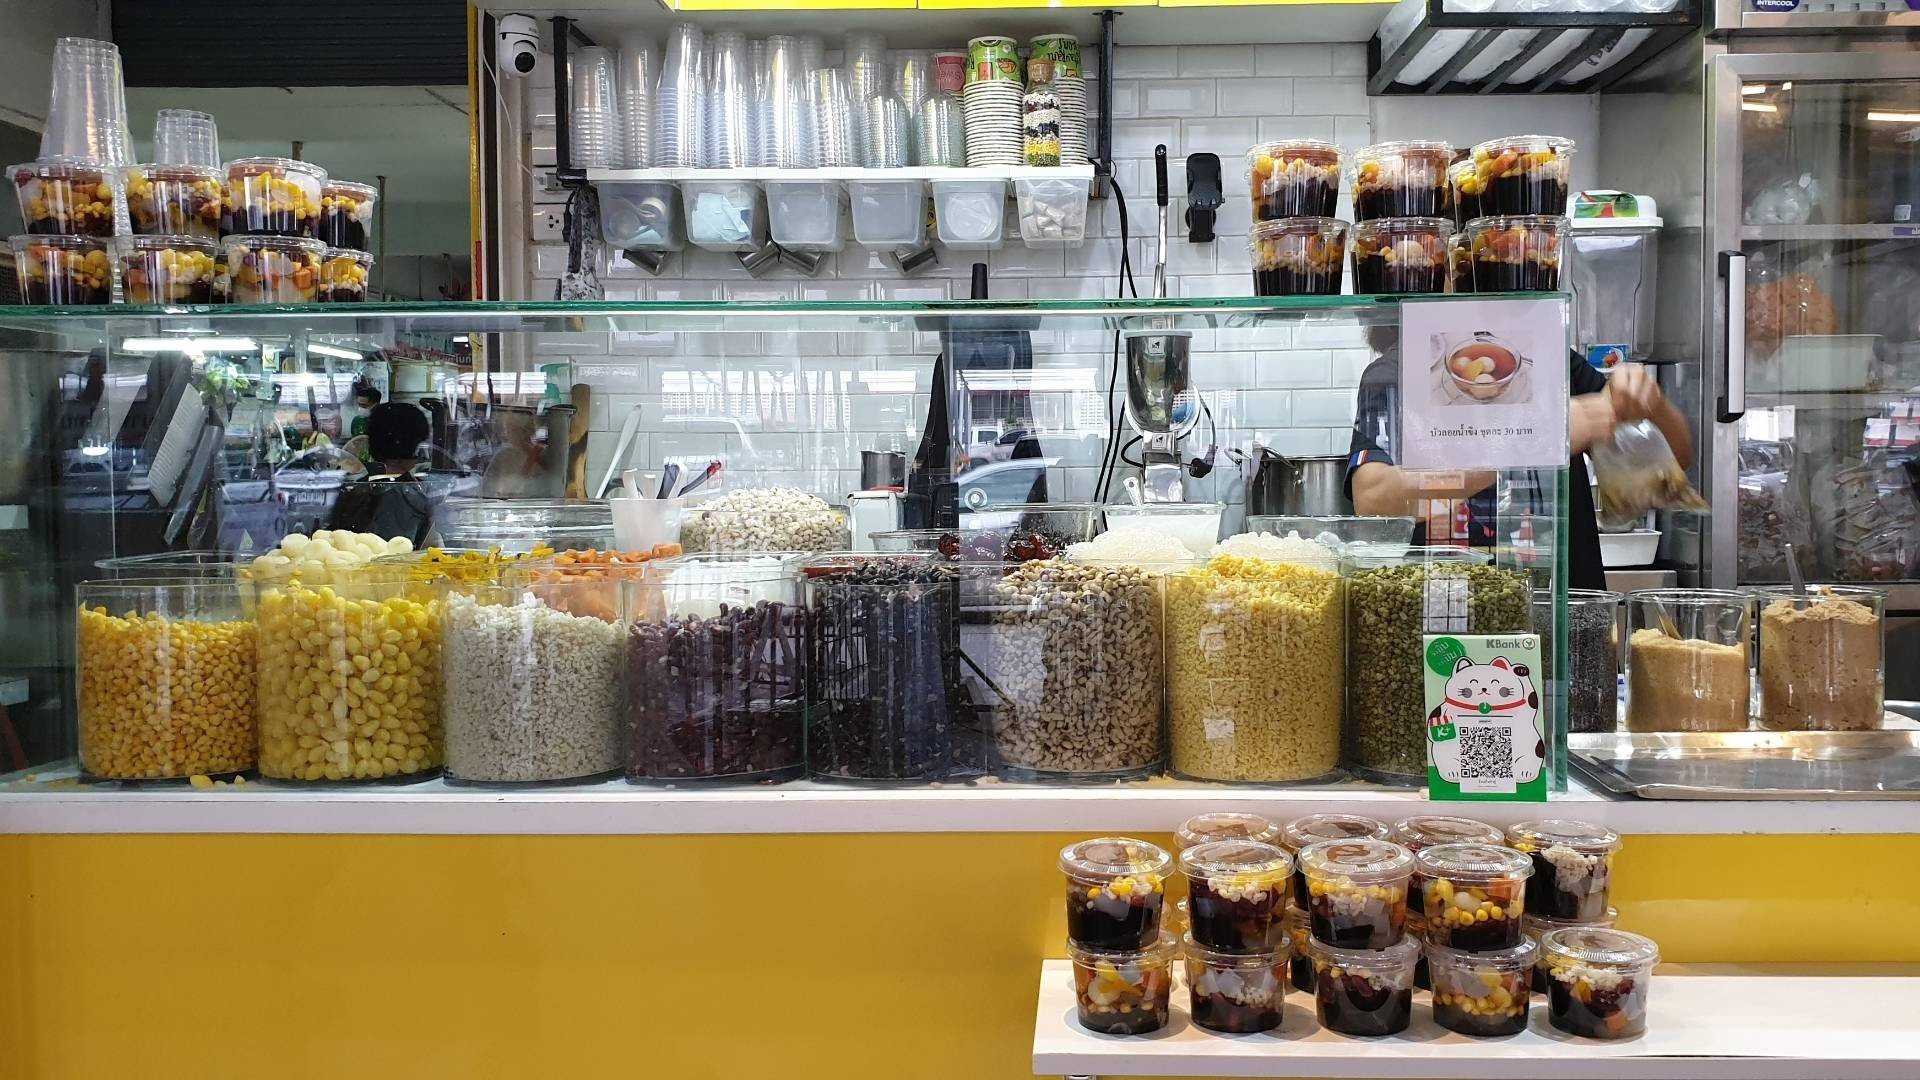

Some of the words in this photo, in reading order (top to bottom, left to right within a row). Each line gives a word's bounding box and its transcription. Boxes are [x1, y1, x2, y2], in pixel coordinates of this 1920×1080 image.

[1504, 427, 1514, 435] 30
[1516, 427, 1533, 435] บาท
[1486, 639, 1520, 648] KBank
